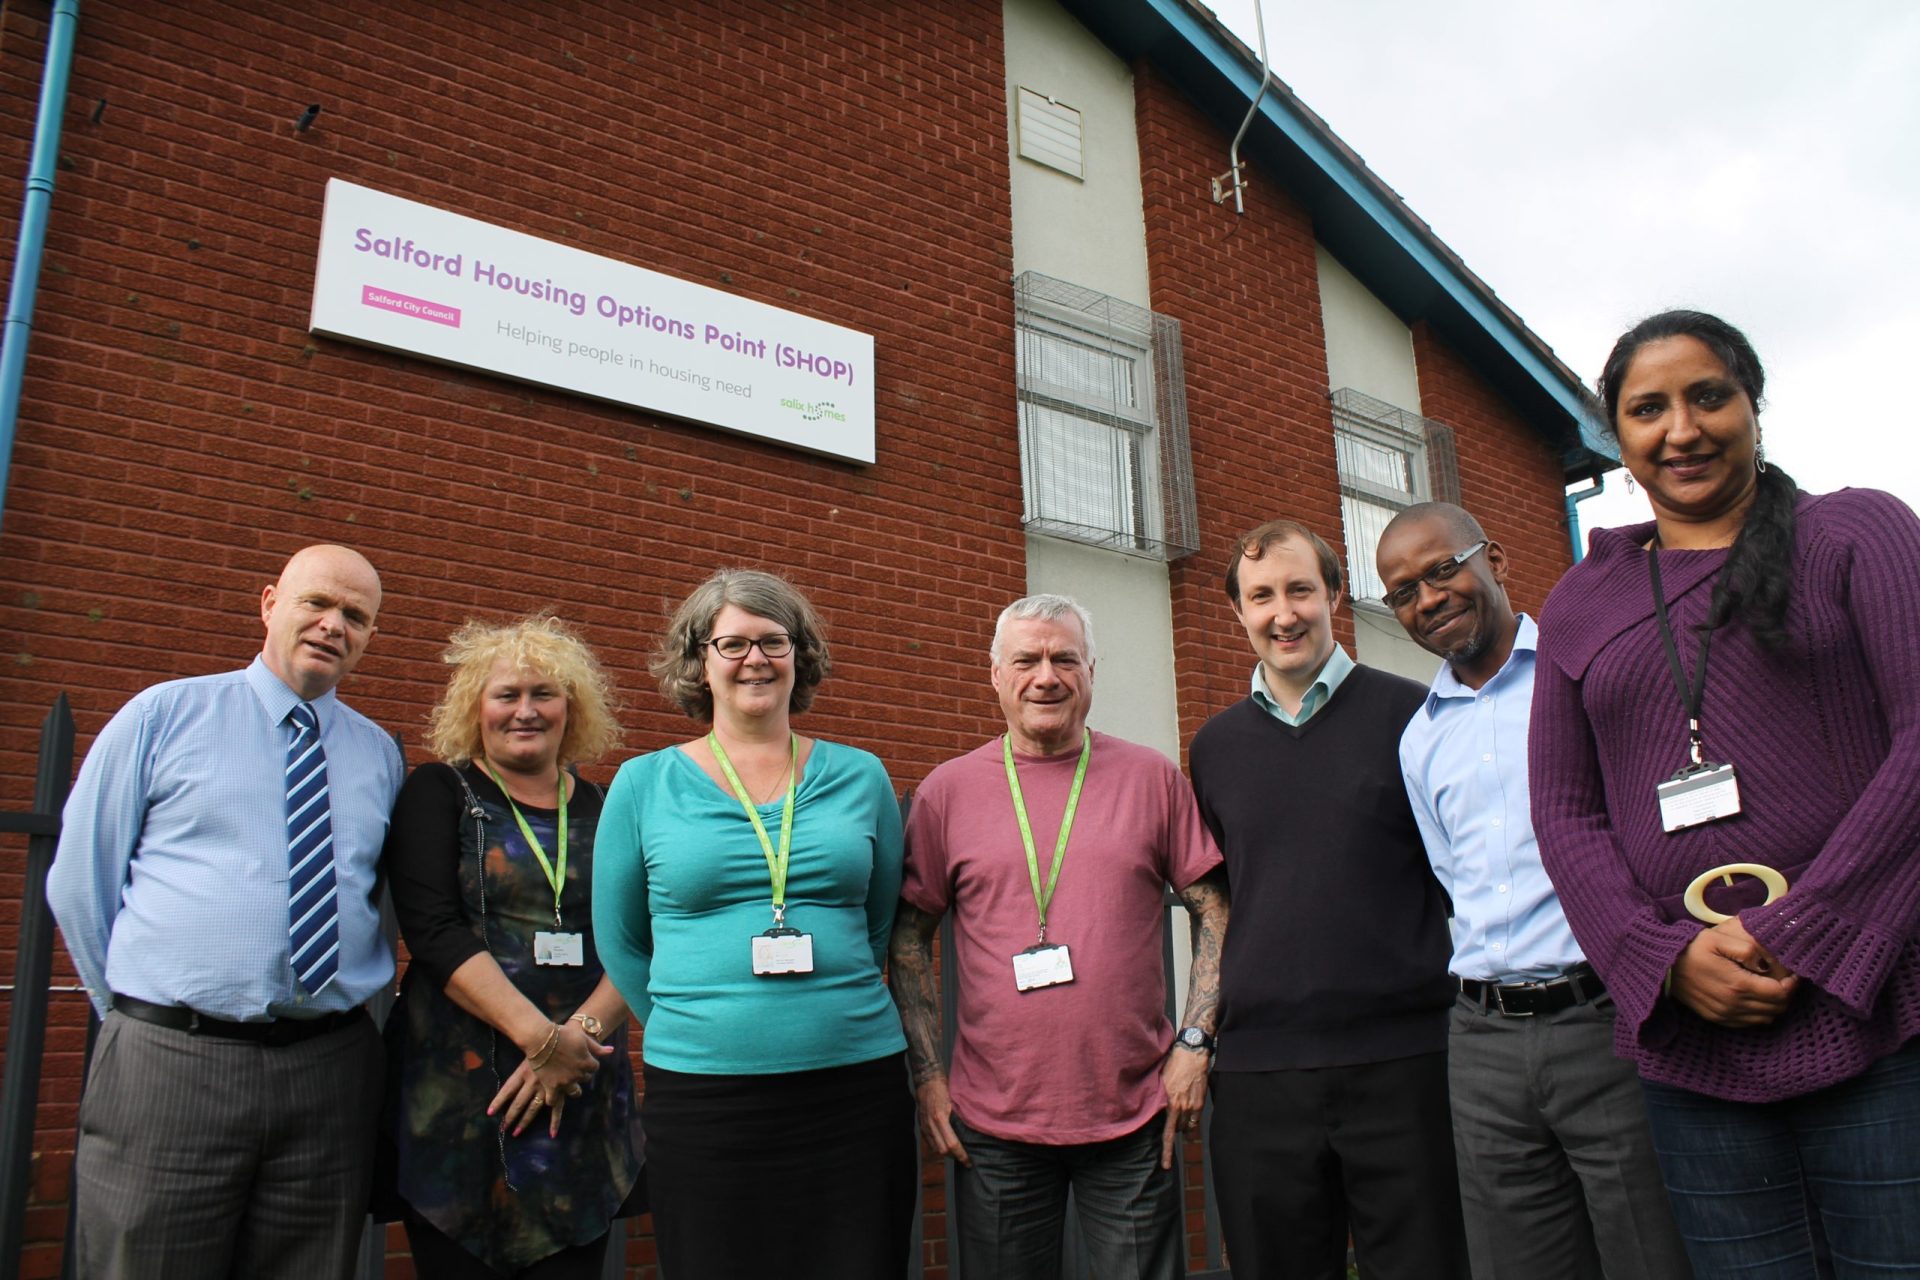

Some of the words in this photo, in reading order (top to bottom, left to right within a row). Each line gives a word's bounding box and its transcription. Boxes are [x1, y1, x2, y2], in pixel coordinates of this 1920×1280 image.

[354, 228, 462, 277] Salford
[474, 261, 585, 315] Housing
[597, 296, 695, 342] Options
[705, 324, 767, 360] Point
[776, 343, 854, 387] (SHOP)
[368, 292, 402, 308] Salford
[403, 301, 421, 314] City
[422, 306, 455, 321] Council
[497, 320, 562, 354] Helping
[568, 342, 623, 365] people
[630, 354, 643, 370] in
[649, 360, 711, 392] housing
[716, 380, 752, 398] need
[780, 398, 805, 411] salix
